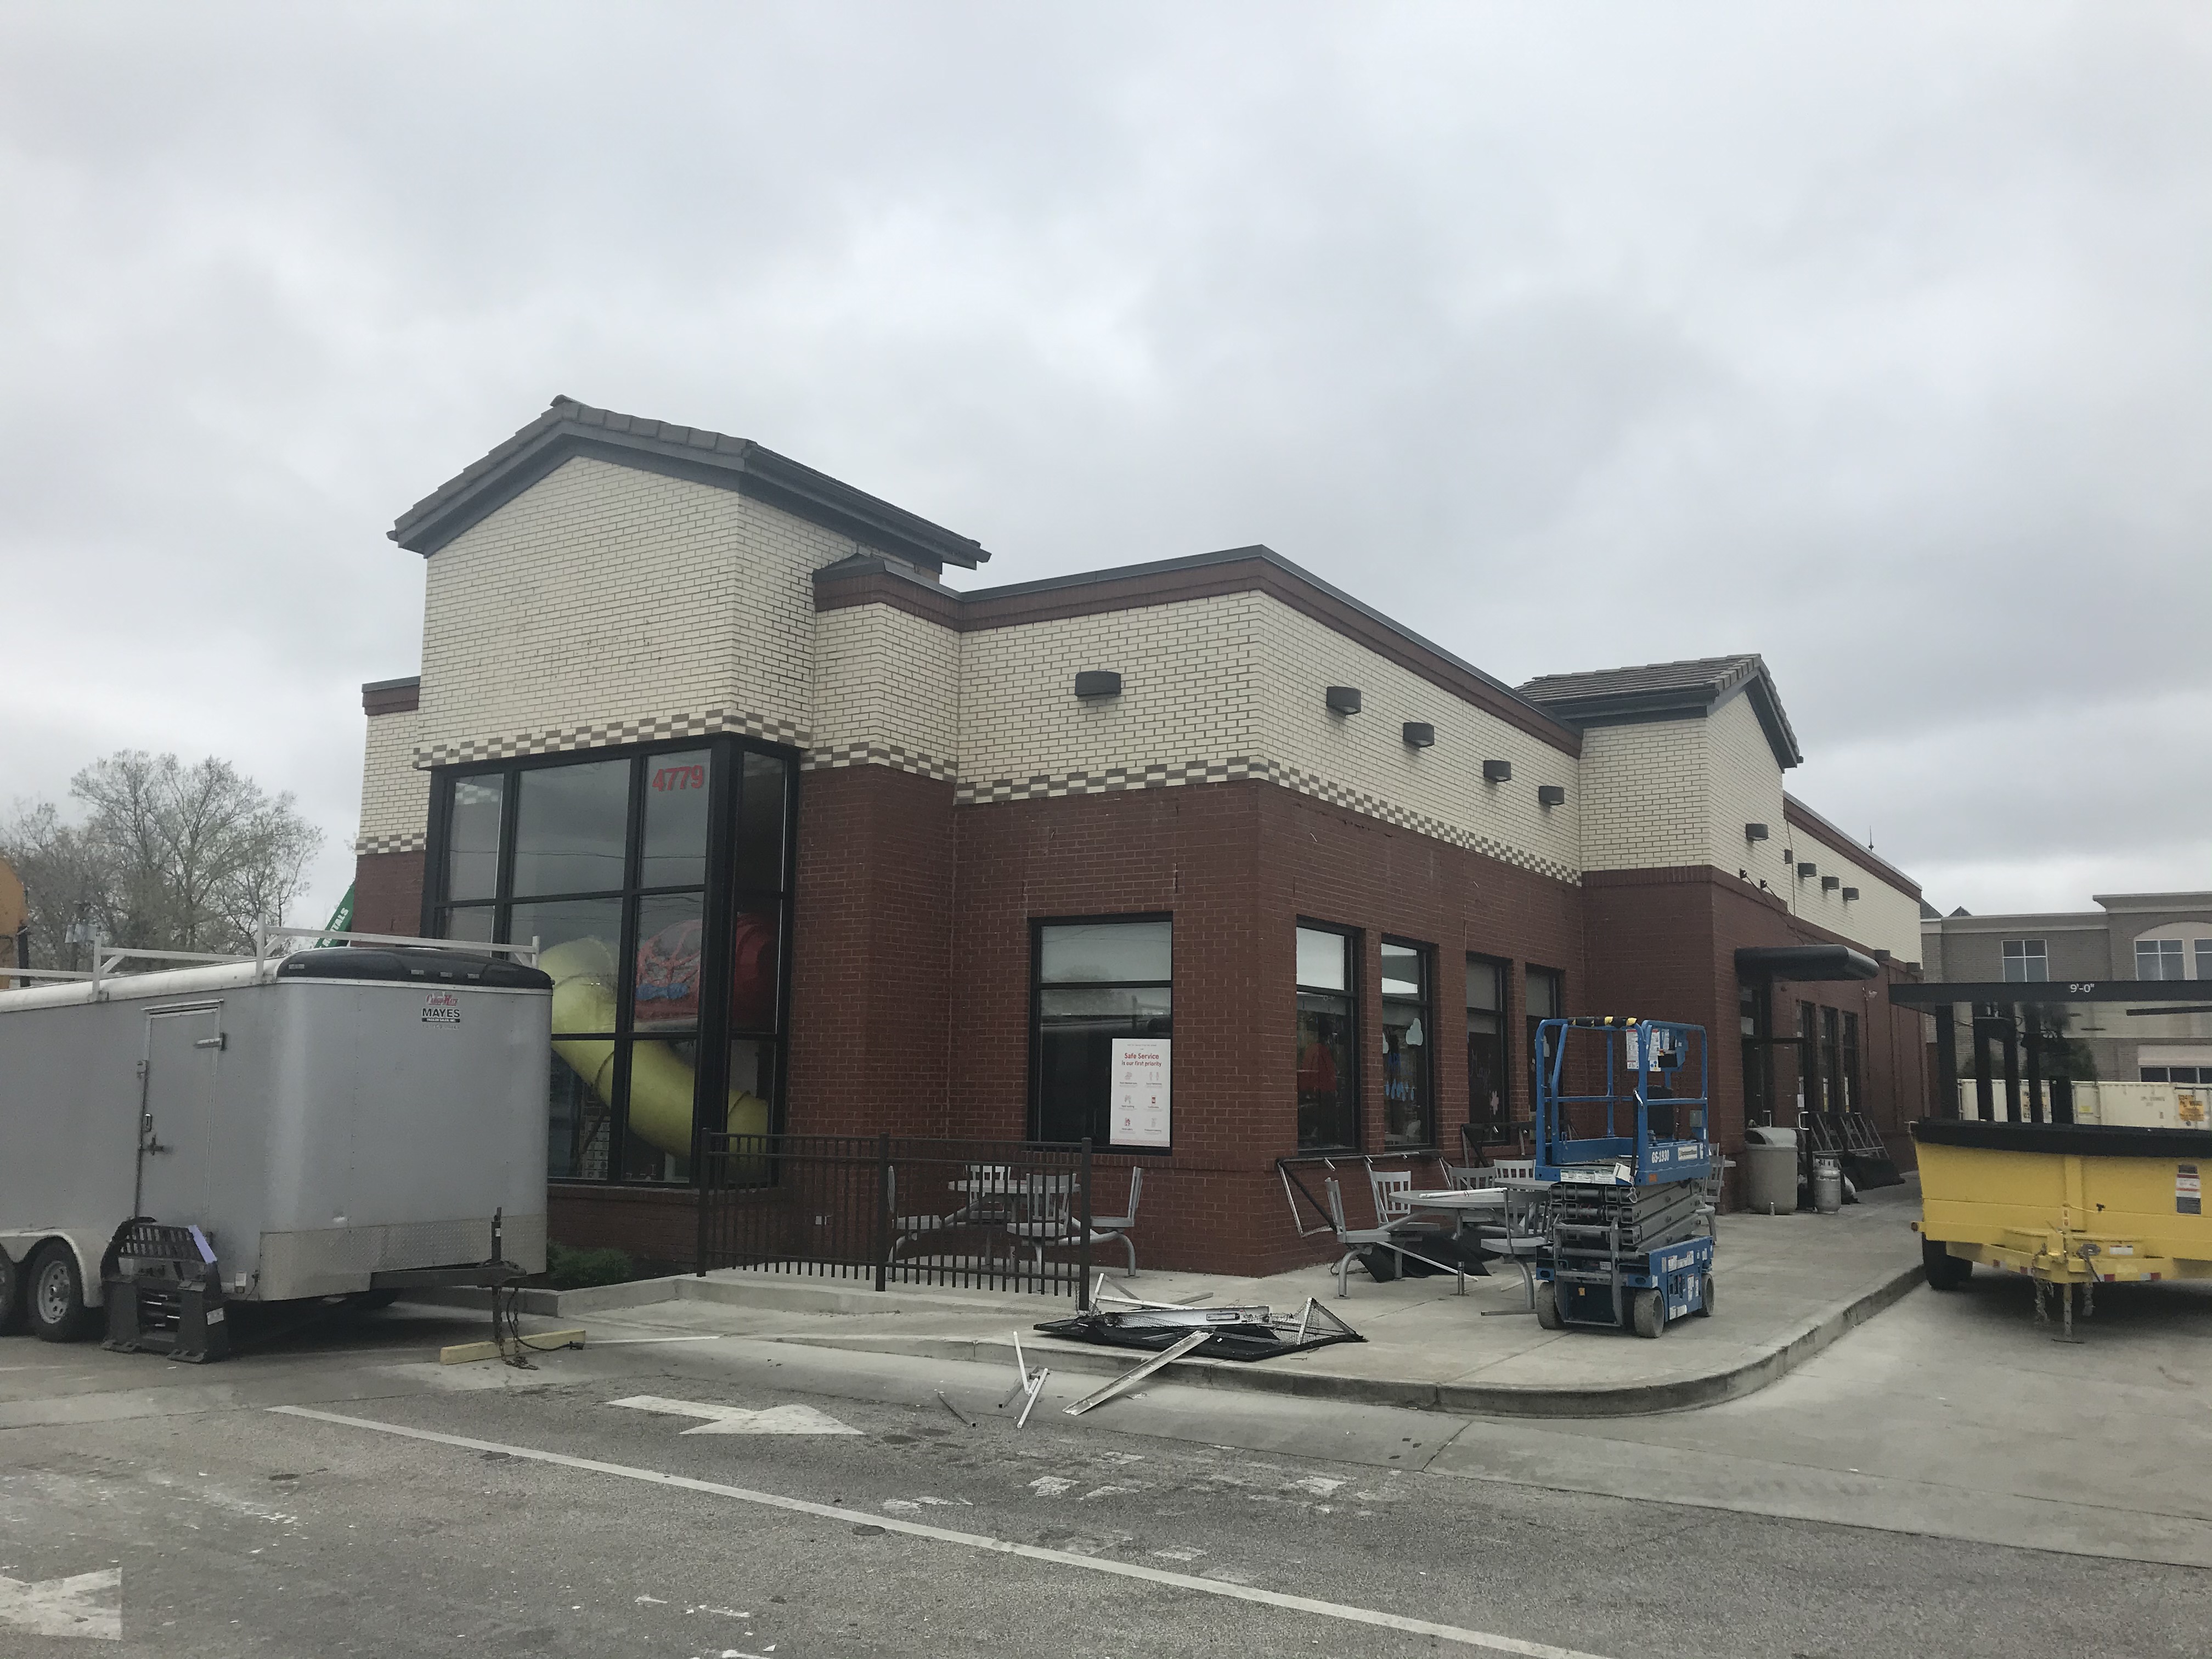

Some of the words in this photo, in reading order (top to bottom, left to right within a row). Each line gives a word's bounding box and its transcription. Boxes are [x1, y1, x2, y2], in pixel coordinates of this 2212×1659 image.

[652, 765, 703, 792] 4779
[422, 1008, 460, 1018] MAYES
[1652, 1149, 1669, 1163] GS-1930
